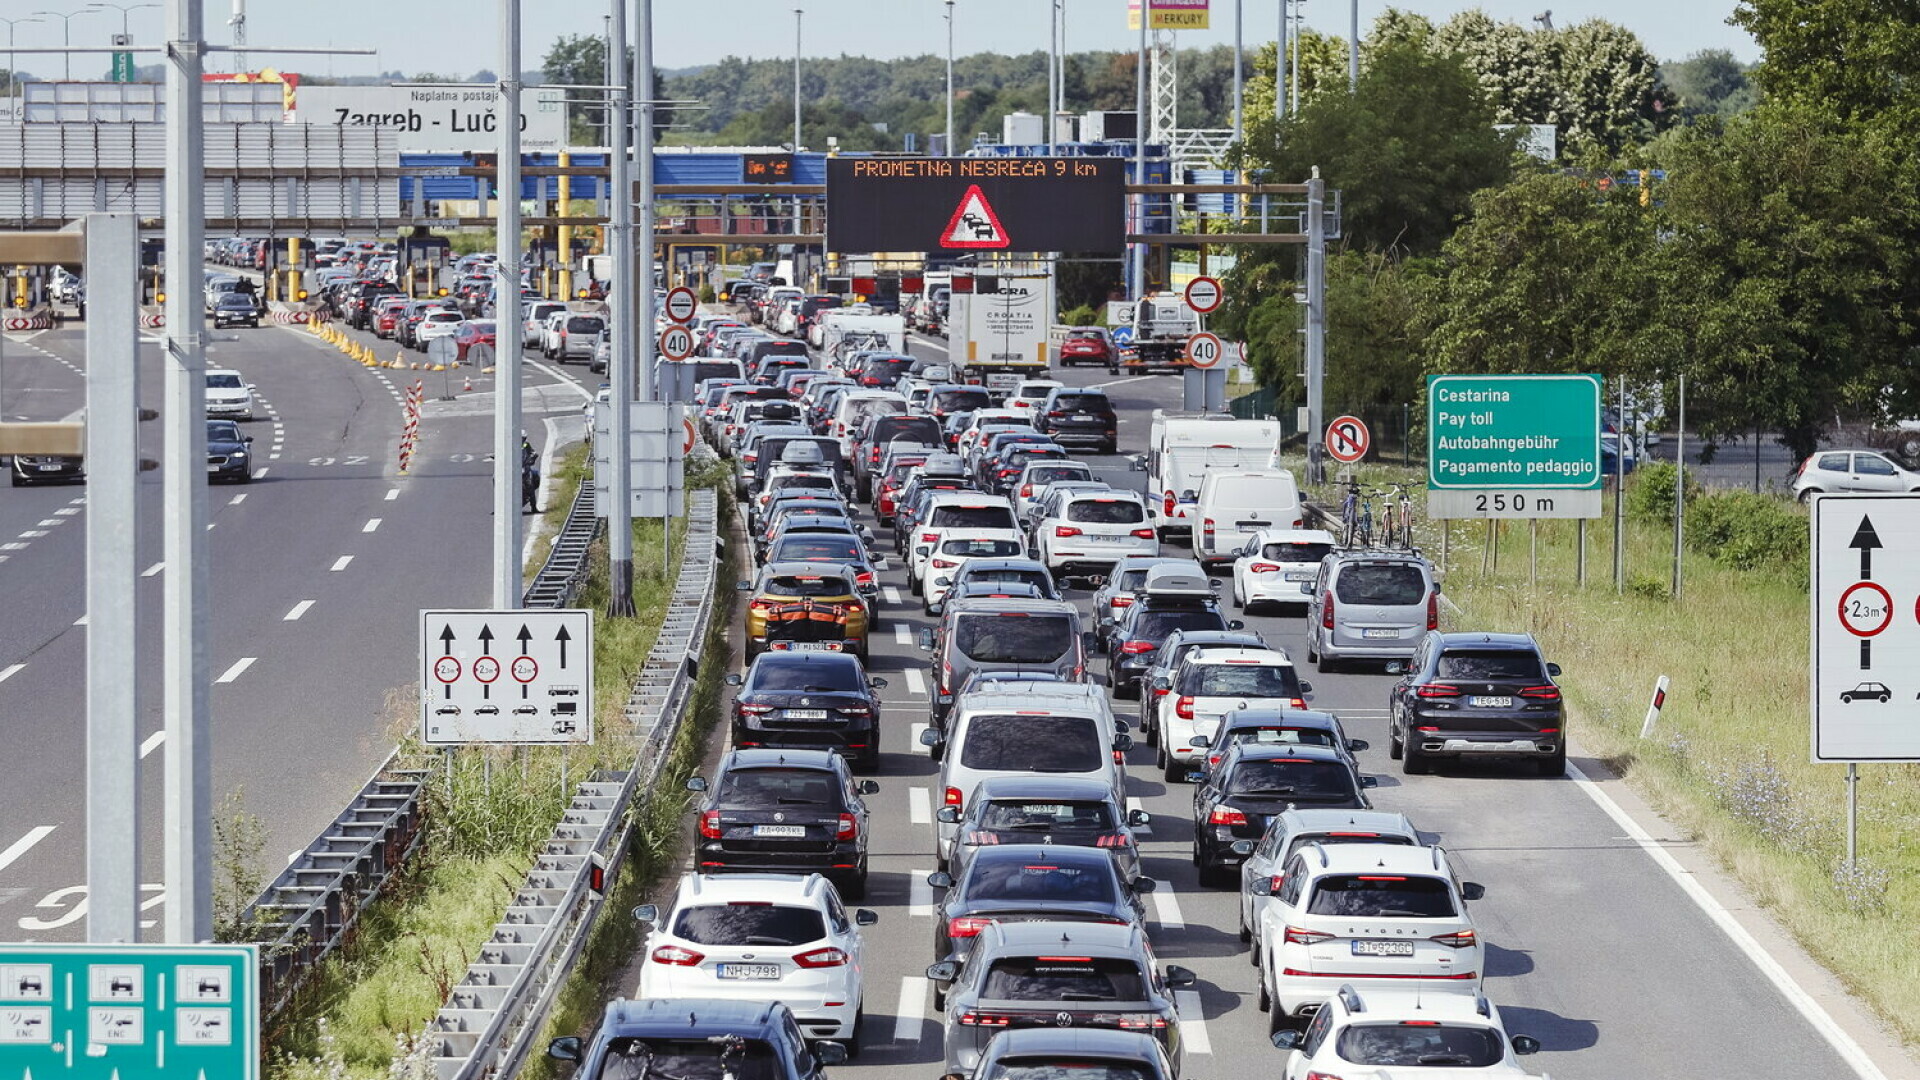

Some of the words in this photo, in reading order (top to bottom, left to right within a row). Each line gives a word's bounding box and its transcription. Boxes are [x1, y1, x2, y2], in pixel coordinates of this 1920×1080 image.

[1155, 13, 1203, 24] MERKURY
[411, 90, 458, 102] Naplatna
[451, 108, 527, 133] Lučo
[854, 161, 952, 177] PROMETNA
[1054, 161, 1066, 177] 9
[1074, 161, 1097, 176] km
[986, 311, 1033, 319] CROATIA
[667, 334, 687, 353] 40
[1193, 342, 1214, 360] 40
[1438, 388, 1511, 403] Cestarina
[1438, 411, 1466, 429] Pay
[1471, 411, 1494, 426] toll
[1438, 434, 1560, 453] Autobahngebühr
[1439, 459, 1523, 477] Pagamento
[1526, 458, 1594, 477] pedaggio
[1475, 494, 1526, 512] 250
[1536, 497, 1555, 512] m
[1851, 600, 1880, 620] 2,3m
[725, 965, 778, 977] NHJ-798
[15, 1029, 34, 1038] ENC
[107, 1029, 125, 1038] ENC
[195, 1030, 213, 1040] ENC
